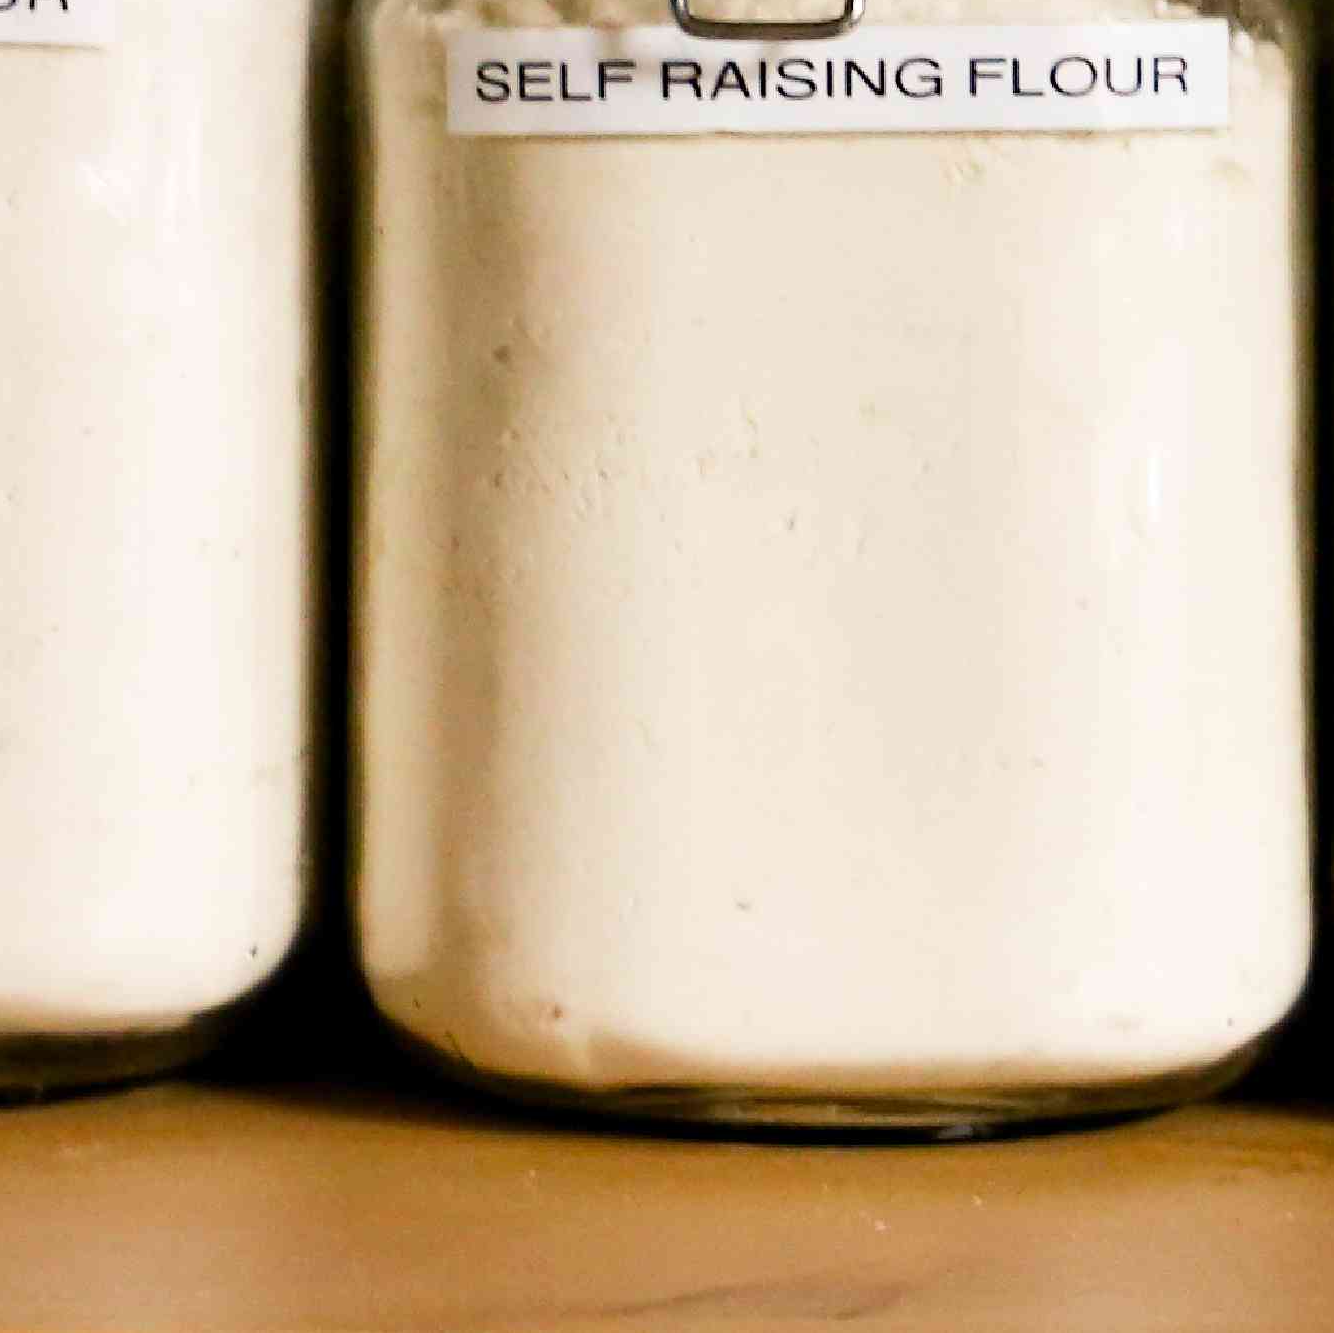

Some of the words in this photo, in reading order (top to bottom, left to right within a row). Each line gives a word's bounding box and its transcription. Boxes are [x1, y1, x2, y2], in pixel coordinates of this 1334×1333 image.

[475, 60, 638, 103] SELF
[661, 57, 944, 102] RAISING
[968, 53, 1189, 98] FLOUR
